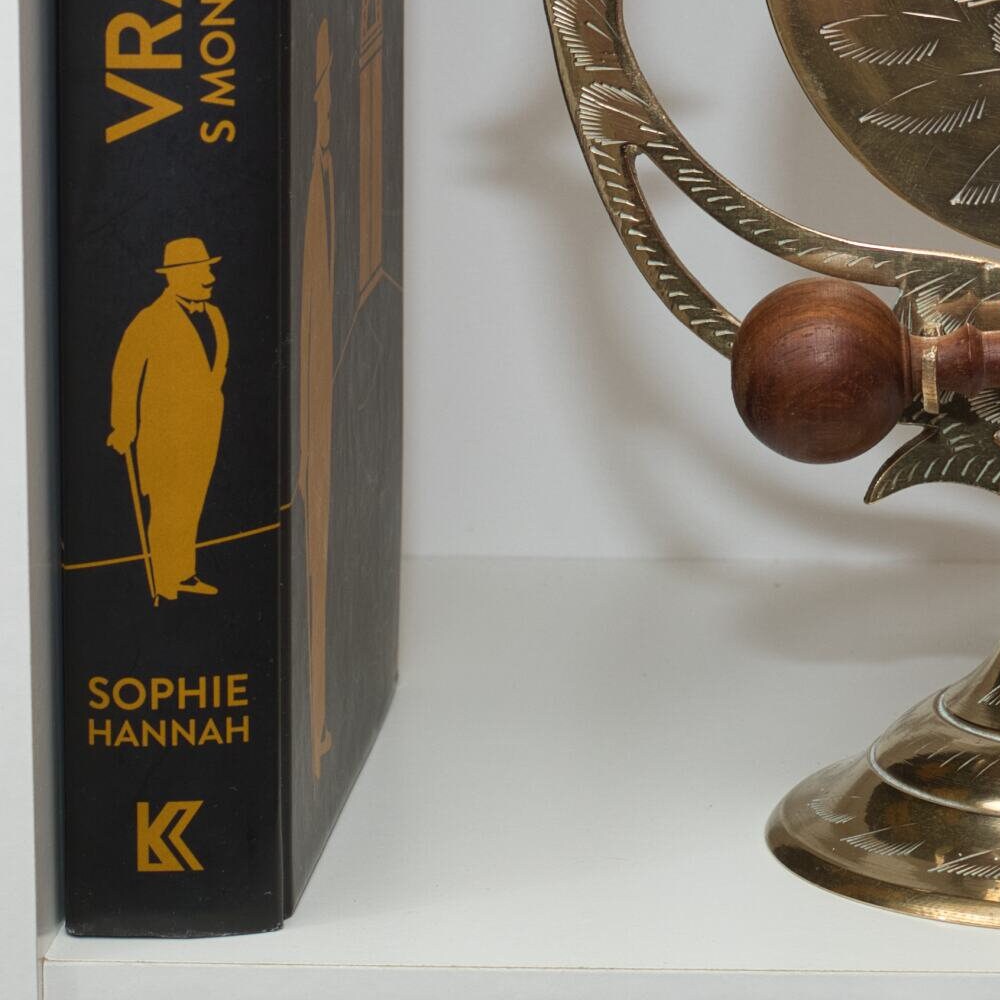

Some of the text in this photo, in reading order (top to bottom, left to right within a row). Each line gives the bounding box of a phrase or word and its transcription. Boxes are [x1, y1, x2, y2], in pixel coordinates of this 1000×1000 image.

[199, 119, 236, 144] S
[88, 673, 249, 711] SOPHIE
[88, 716, 250, 747] HANNAH
